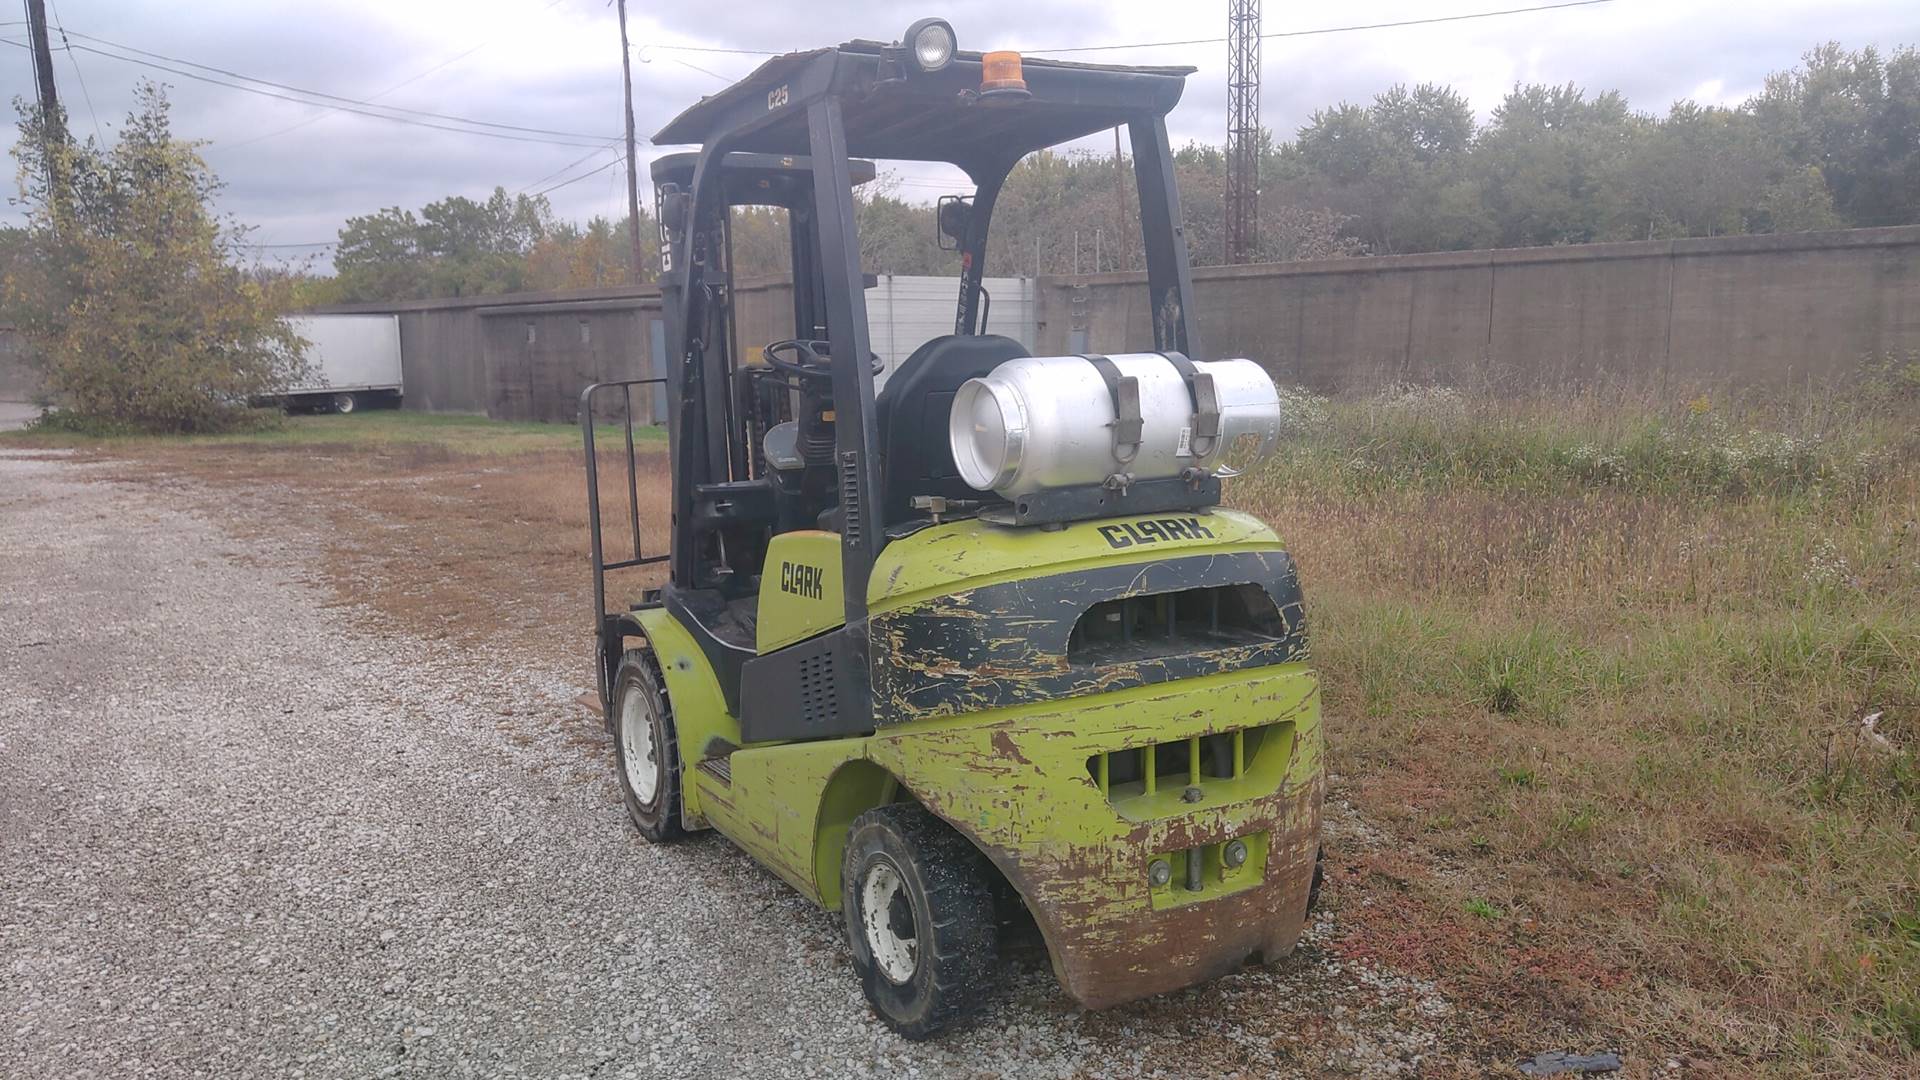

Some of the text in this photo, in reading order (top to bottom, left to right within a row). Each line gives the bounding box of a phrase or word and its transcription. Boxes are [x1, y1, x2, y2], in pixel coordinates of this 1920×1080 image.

[768, 84, 788, 110] C25
[1097, 518, 1215, 549] CLARK
[781, 561, 823, 601] CLARK
